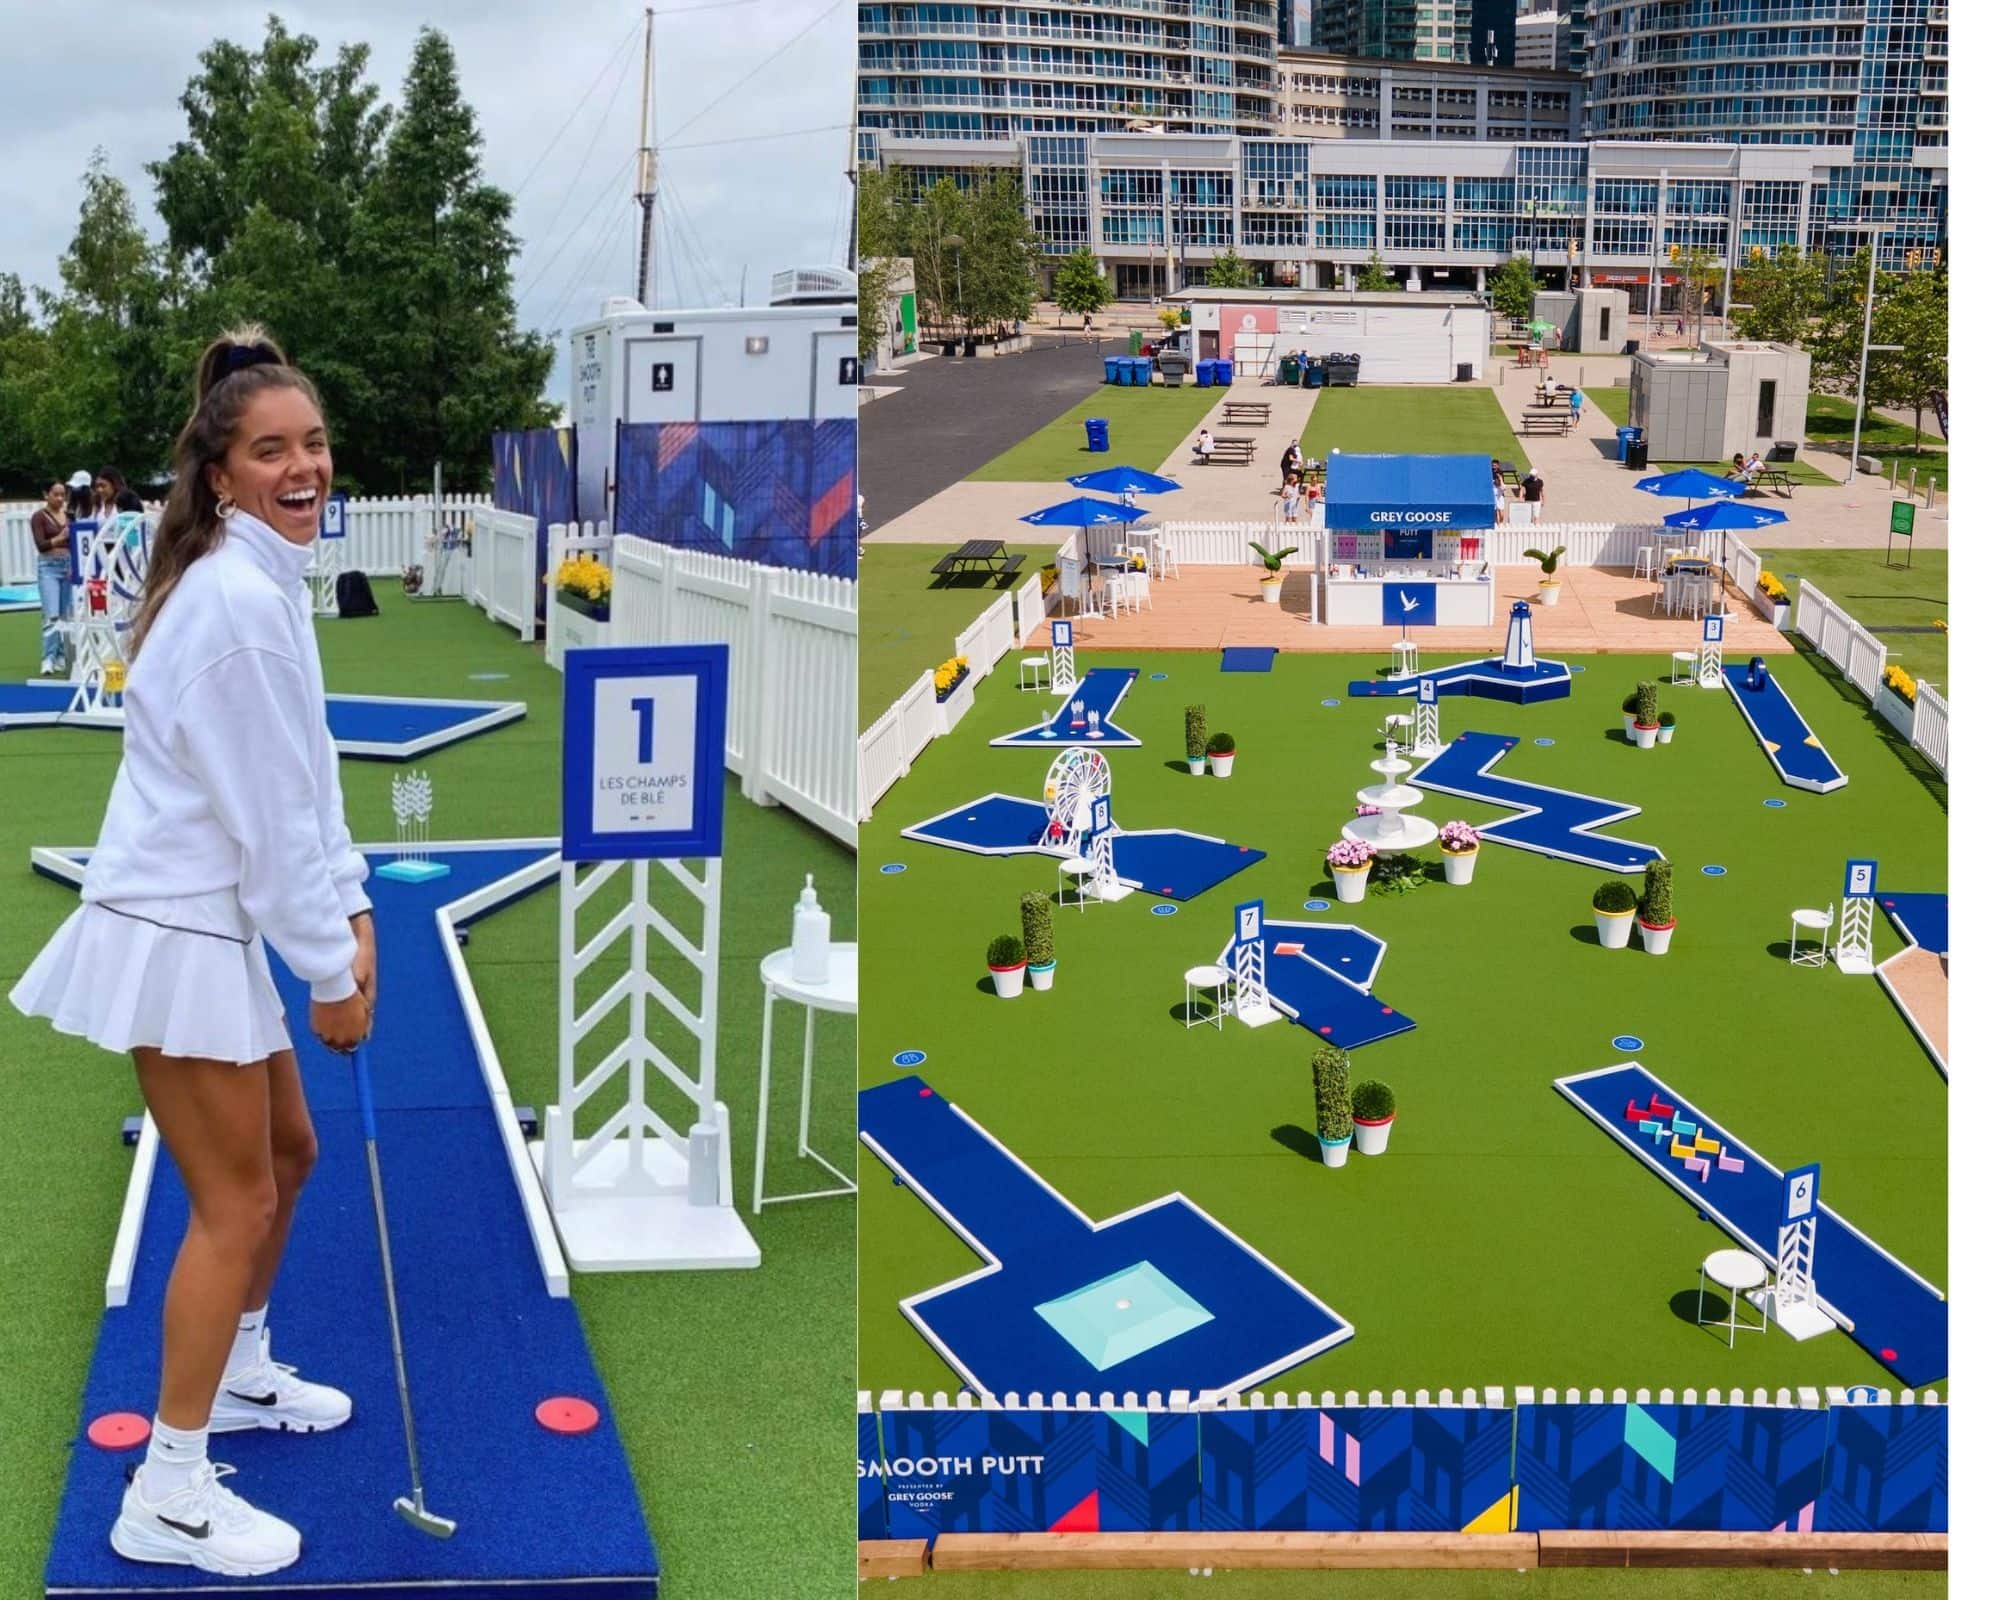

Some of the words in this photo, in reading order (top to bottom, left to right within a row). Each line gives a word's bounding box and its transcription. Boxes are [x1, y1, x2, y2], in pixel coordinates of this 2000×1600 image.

[328, 504, 337, 519] 9
[1370, 511, 1403, 523] GREY
[1405, 511, 1450, 523] GOOSE
[81, 537, 89, 556] 8
[1711, 622, 1717, 631] 3
[1423, 682, 1431, 691] 4
[630, 697, 654, 764] 1
[600, 776, 624, 790] LES
[626, 774, 688, 789] CHAMPS
[621, 793, 639, 805] DE
[640, 790, 665, 805] BLÉ
[1856, 869, 1866, 881] 5
[1245, 911, 1254, 926] 7
[1796, 1181, 1806, 1198] 6
[857, 1457, 972, 1478] SMOOTH
[982, 1456, 1044, 1475] PUTT
[888, 1493, 915, 1501] GREY
[916, 1492, 953, 1501] GOOSE
